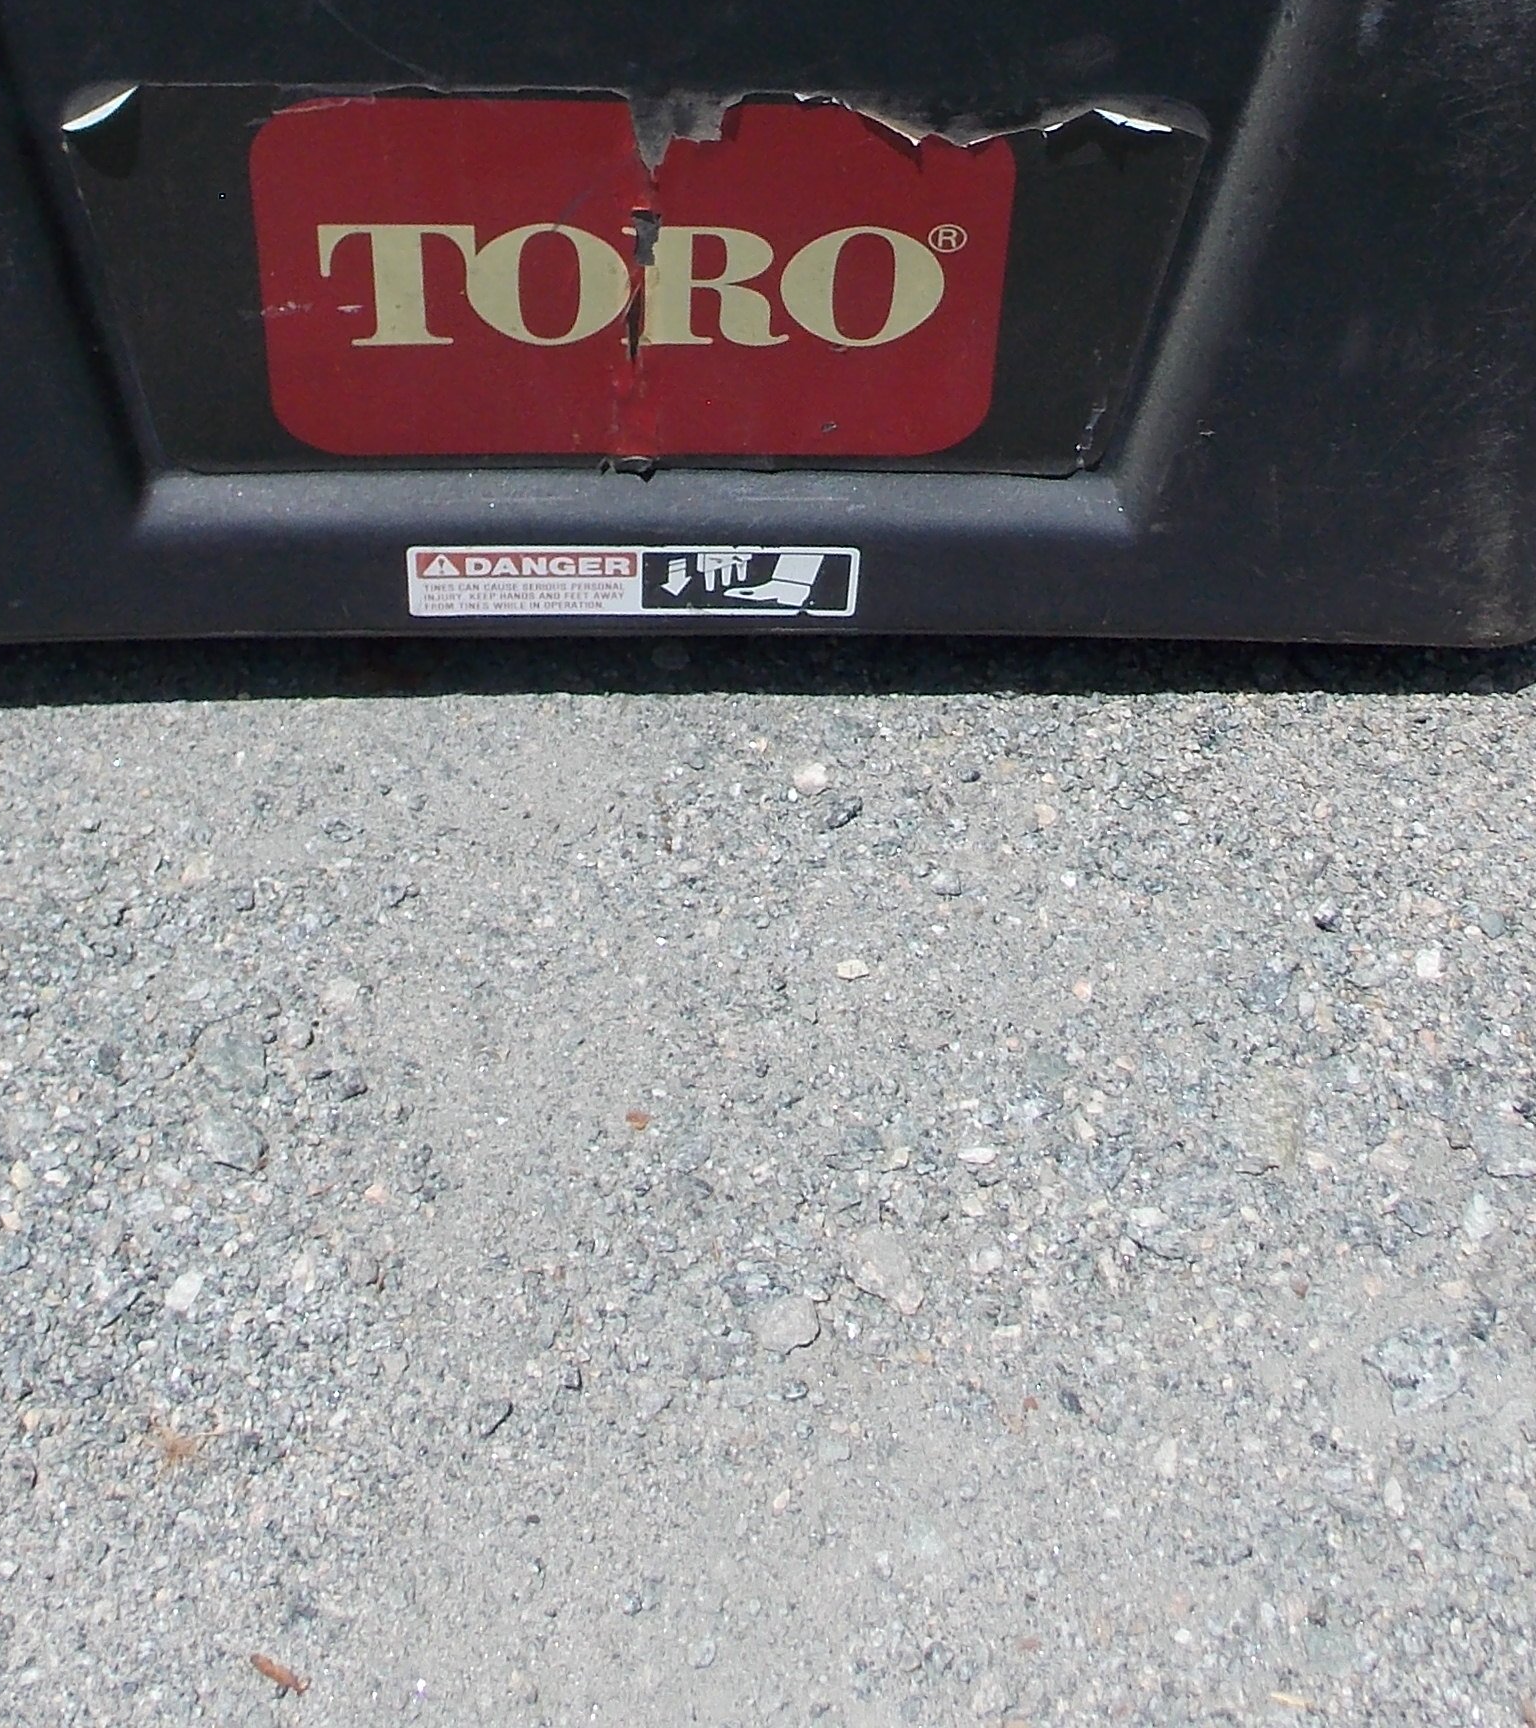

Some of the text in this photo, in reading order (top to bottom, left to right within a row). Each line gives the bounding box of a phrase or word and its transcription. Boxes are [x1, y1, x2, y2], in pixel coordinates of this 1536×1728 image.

[464, 556, 631, 576] DANGER
[458, 583, 480, 591] CAN
[483, 583, 518, 591] CAUSE
[522, 583, 567, 591] SERIOUS
[570, 582, 624, 591] PERSONAL
[499, 592, 535, 600] HANDS
[539, 592, 561, 600] AND
[593, 592, 625, 600] AWAY
